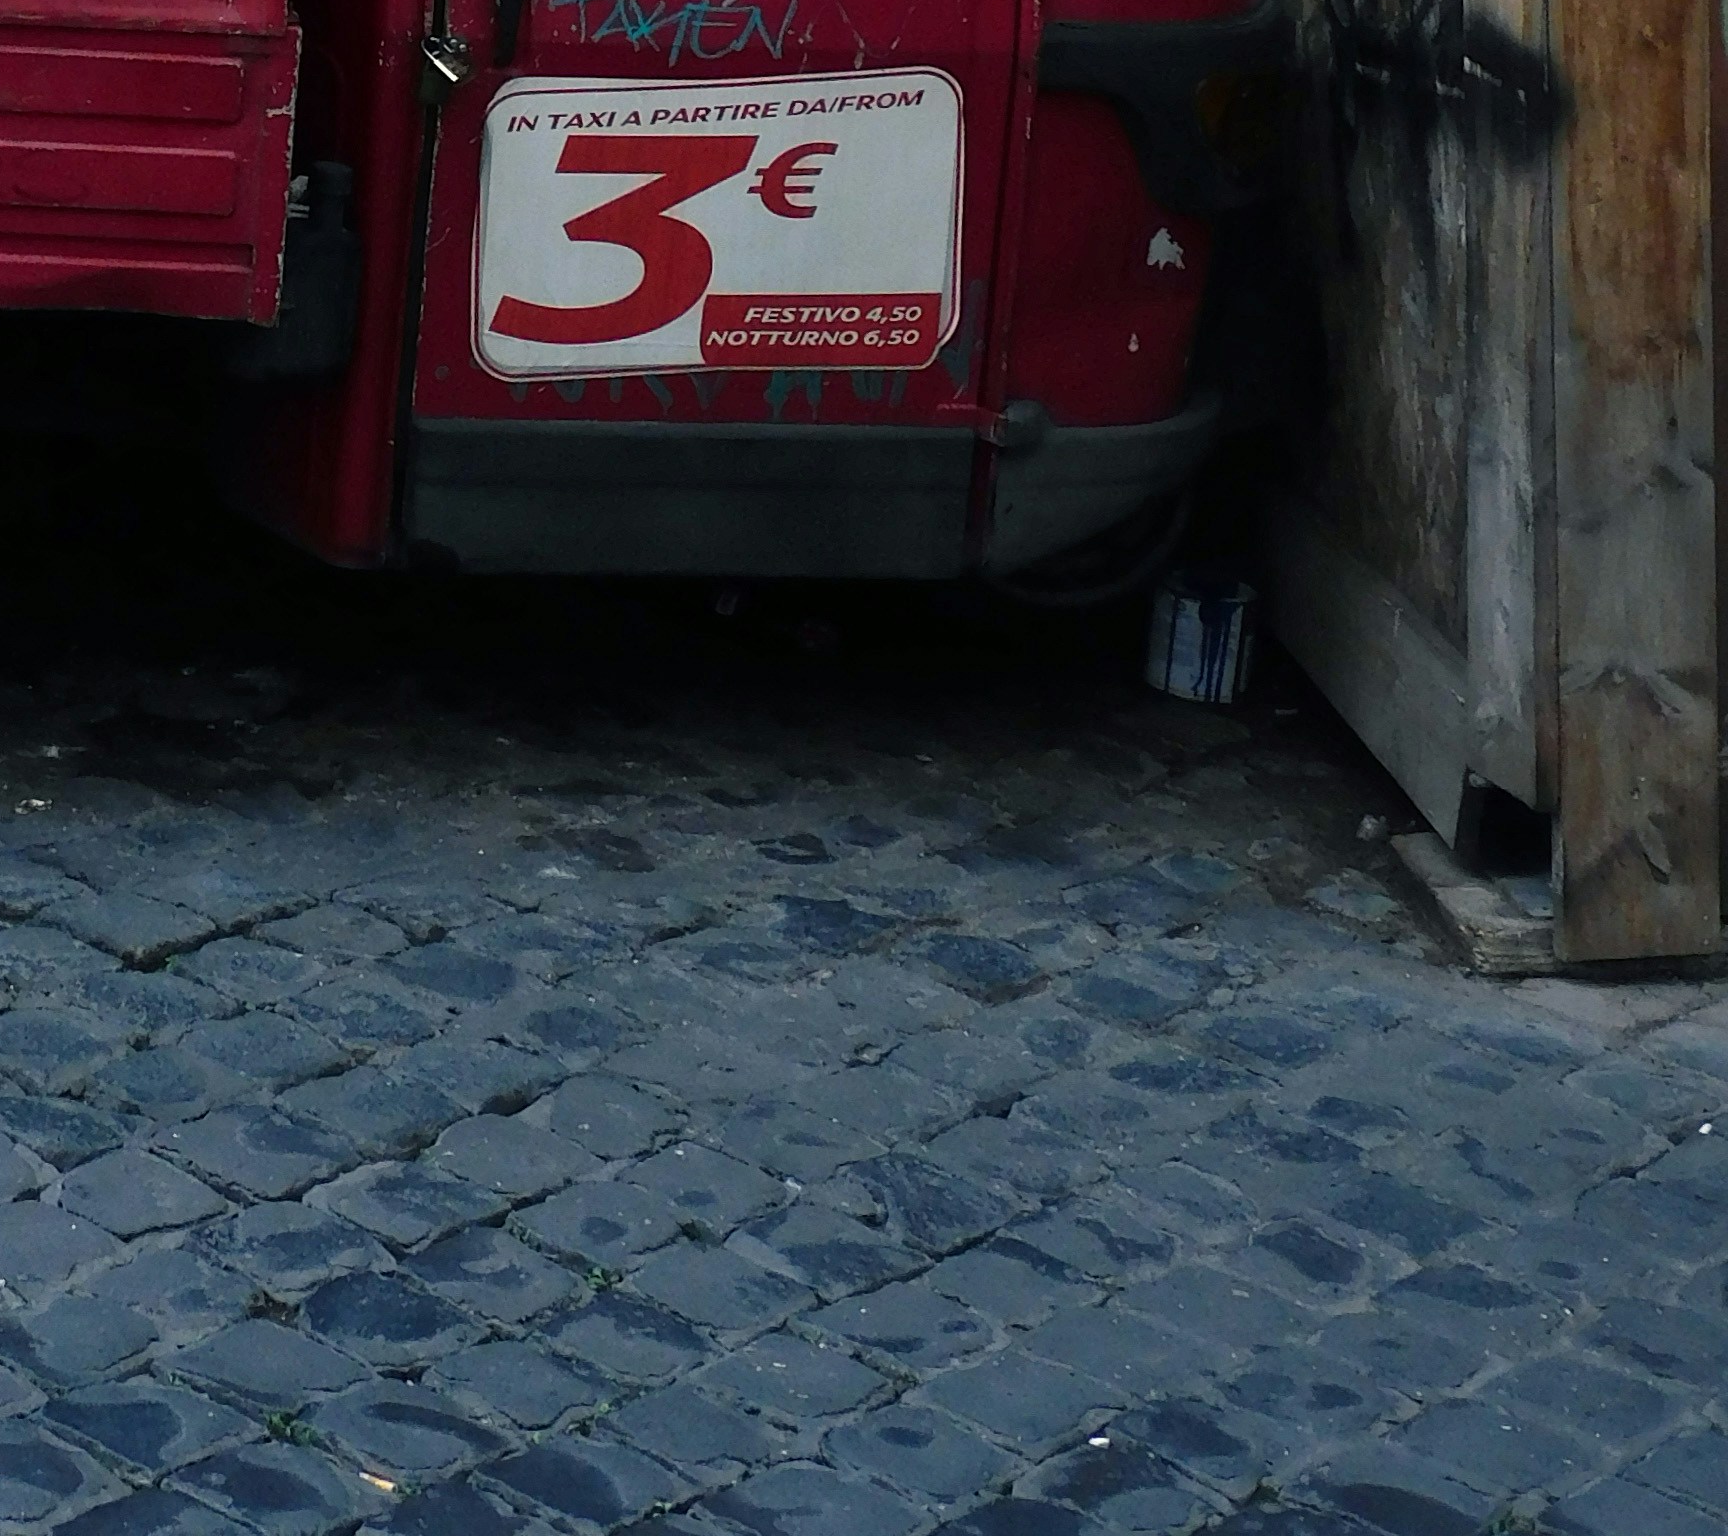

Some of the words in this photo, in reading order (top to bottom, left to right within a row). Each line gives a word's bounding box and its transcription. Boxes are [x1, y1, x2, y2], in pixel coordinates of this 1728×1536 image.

[506, 115, 539, 133] IN
[549, 111, 617, 130] TAXI
[620, 109, 642, 127] A
[650, 101, 783, 127] PARTIRE
[785, 89, 925, 117] DA/FROM
[743, 306, 861, 325] FESTIVO
[864, 305, 923, 326] 4,50
[705, 330, 859, 347] NOTTURNO
[862, 329, 921, 348] 6,50
